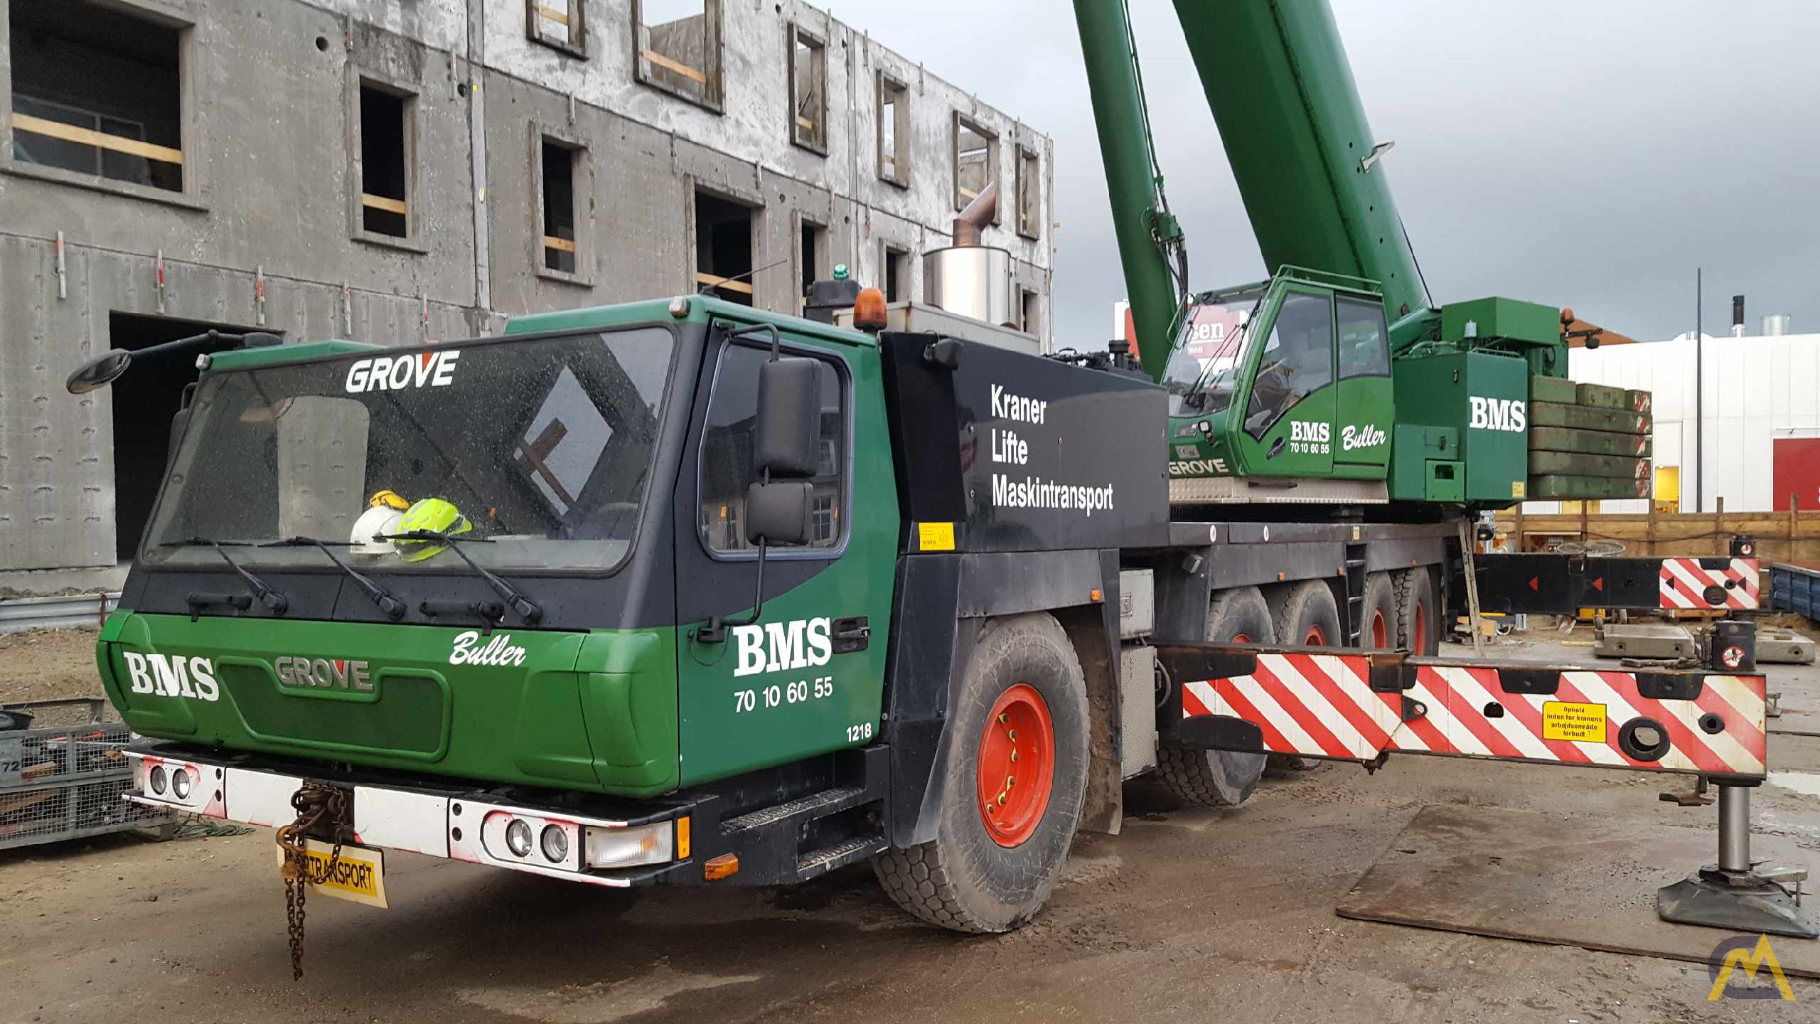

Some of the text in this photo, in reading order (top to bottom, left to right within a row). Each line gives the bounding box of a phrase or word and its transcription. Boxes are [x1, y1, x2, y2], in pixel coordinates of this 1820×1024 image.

[345, 350, 461, 393] GROVE
[991, 384, 1047, 424] Kraner
[1469, 396, 1526, 433] BMS
[992, 428, 1029, 465] Lifte
[1290, 421, 1330, 443] BMS
[1290, 443, 1300, 453] 70
[1300, 443, 1308, 454] 10
[1310, 444, 1319, 454] 60
[1341, 423, 1387, 451] Buller
[1169, 458, 1229, 475] GROVE
[992, 473, 1114, 517] Maskintransport
[449, 630, 527, 667] Buller
[732, 617, 833, 677] BMS
[123, 651, 220, 702] BMS
[274, 656, 375, 691] GROVE
[734, 676, 833, 713] 70 10 60 55
[846, 722, 872, 743] 1218
[304, 855, 372, 890] TRANSPORT
